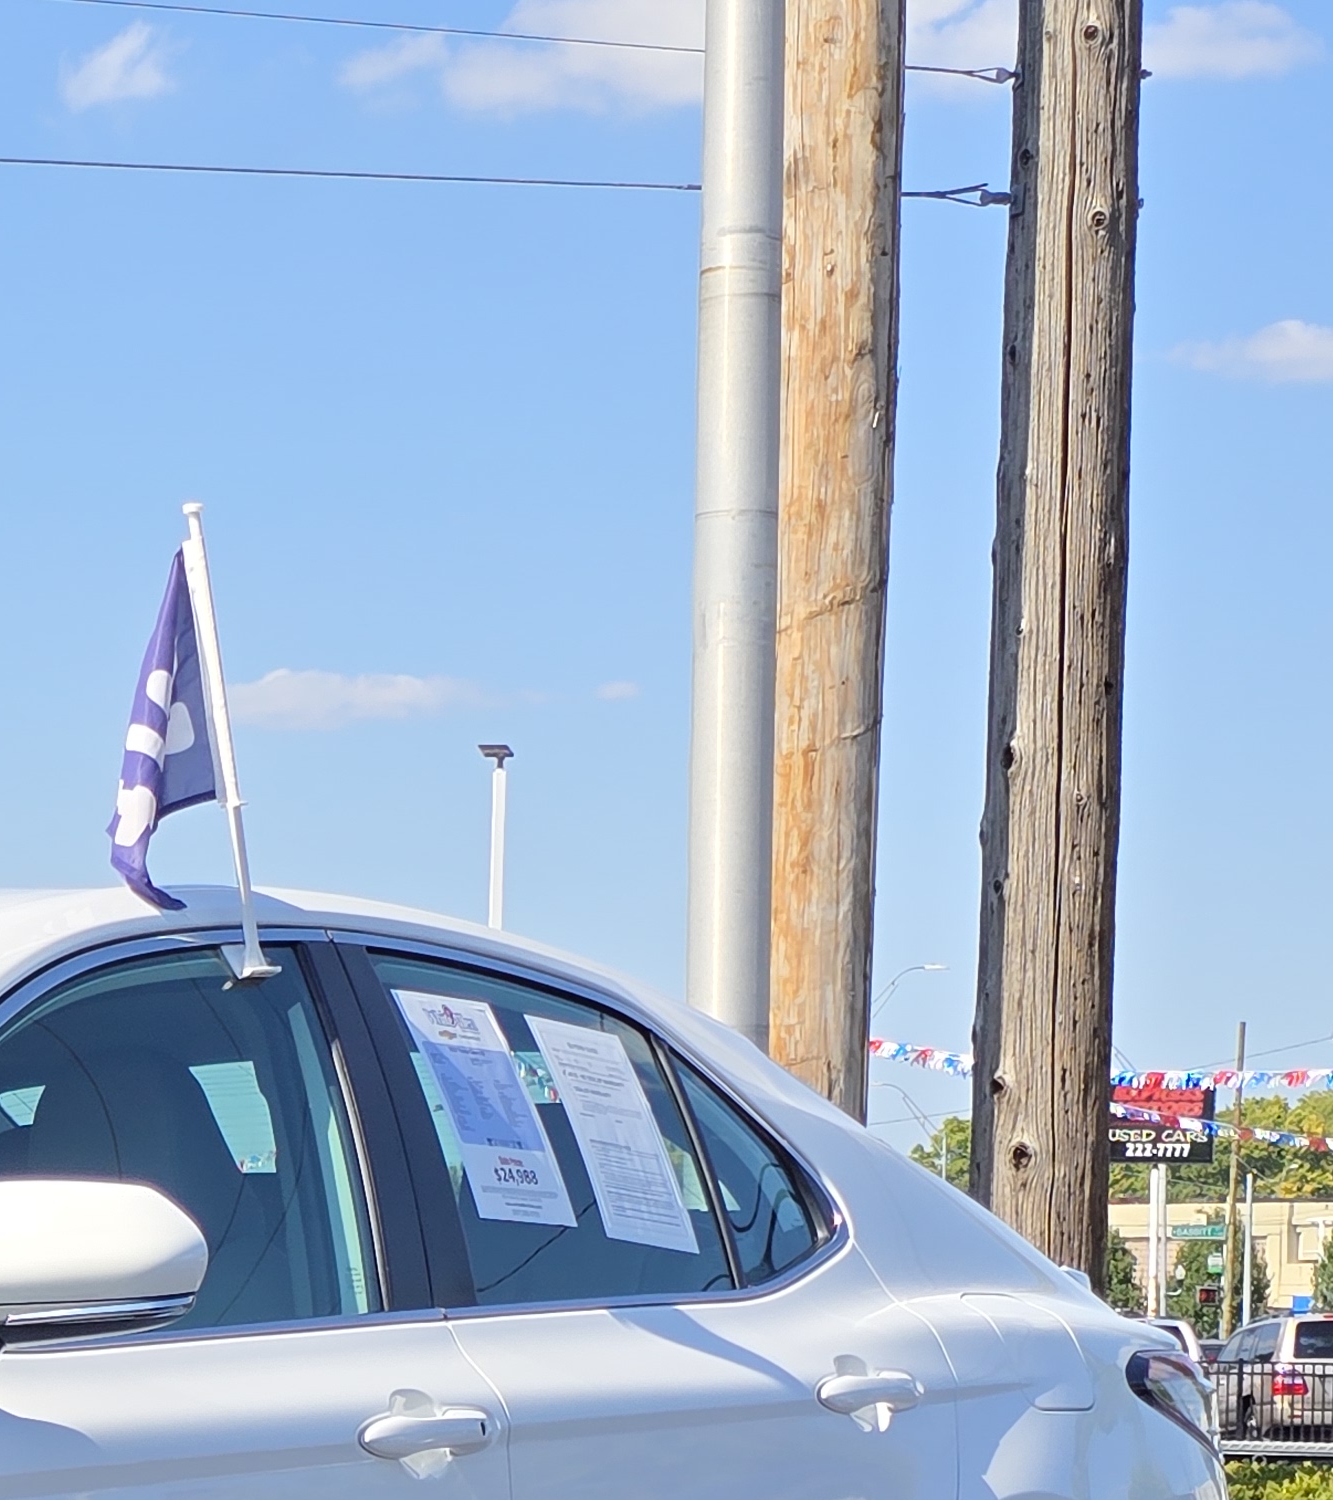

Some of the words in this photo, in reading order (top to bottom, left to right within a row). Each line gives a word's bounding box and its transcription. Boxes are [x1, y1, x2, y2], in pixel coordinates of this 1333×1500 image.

[1108, 1129, 1156, 1142] USED
[1162, 1129, 1208, 1142] CARS
[1125, 1143, 1191, 1157] 222-7777
[494, 1167, 539, 1186] $24,988
